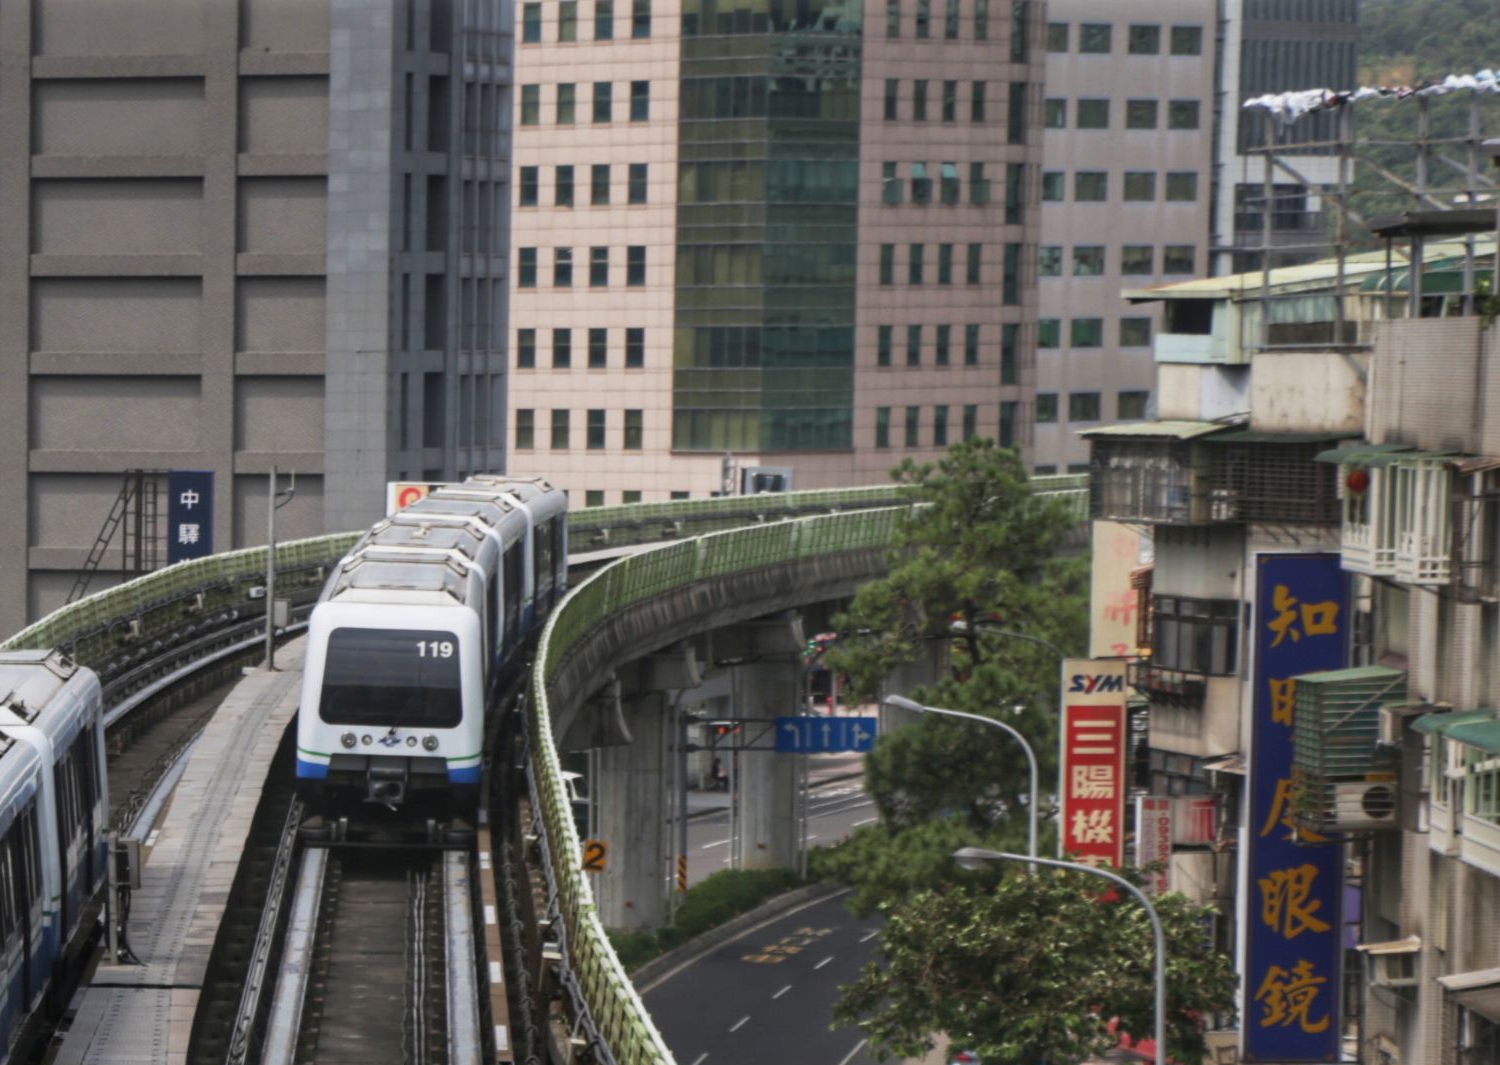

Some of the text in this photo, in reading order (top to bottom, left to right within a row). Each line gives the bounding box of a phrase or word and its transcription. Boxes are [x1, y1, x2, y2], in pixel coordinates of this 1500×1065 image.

[417, 641, 454, 658] 119
[1068, 674, 1124, 694] SYM
[582, 843, 606, 872] 2
